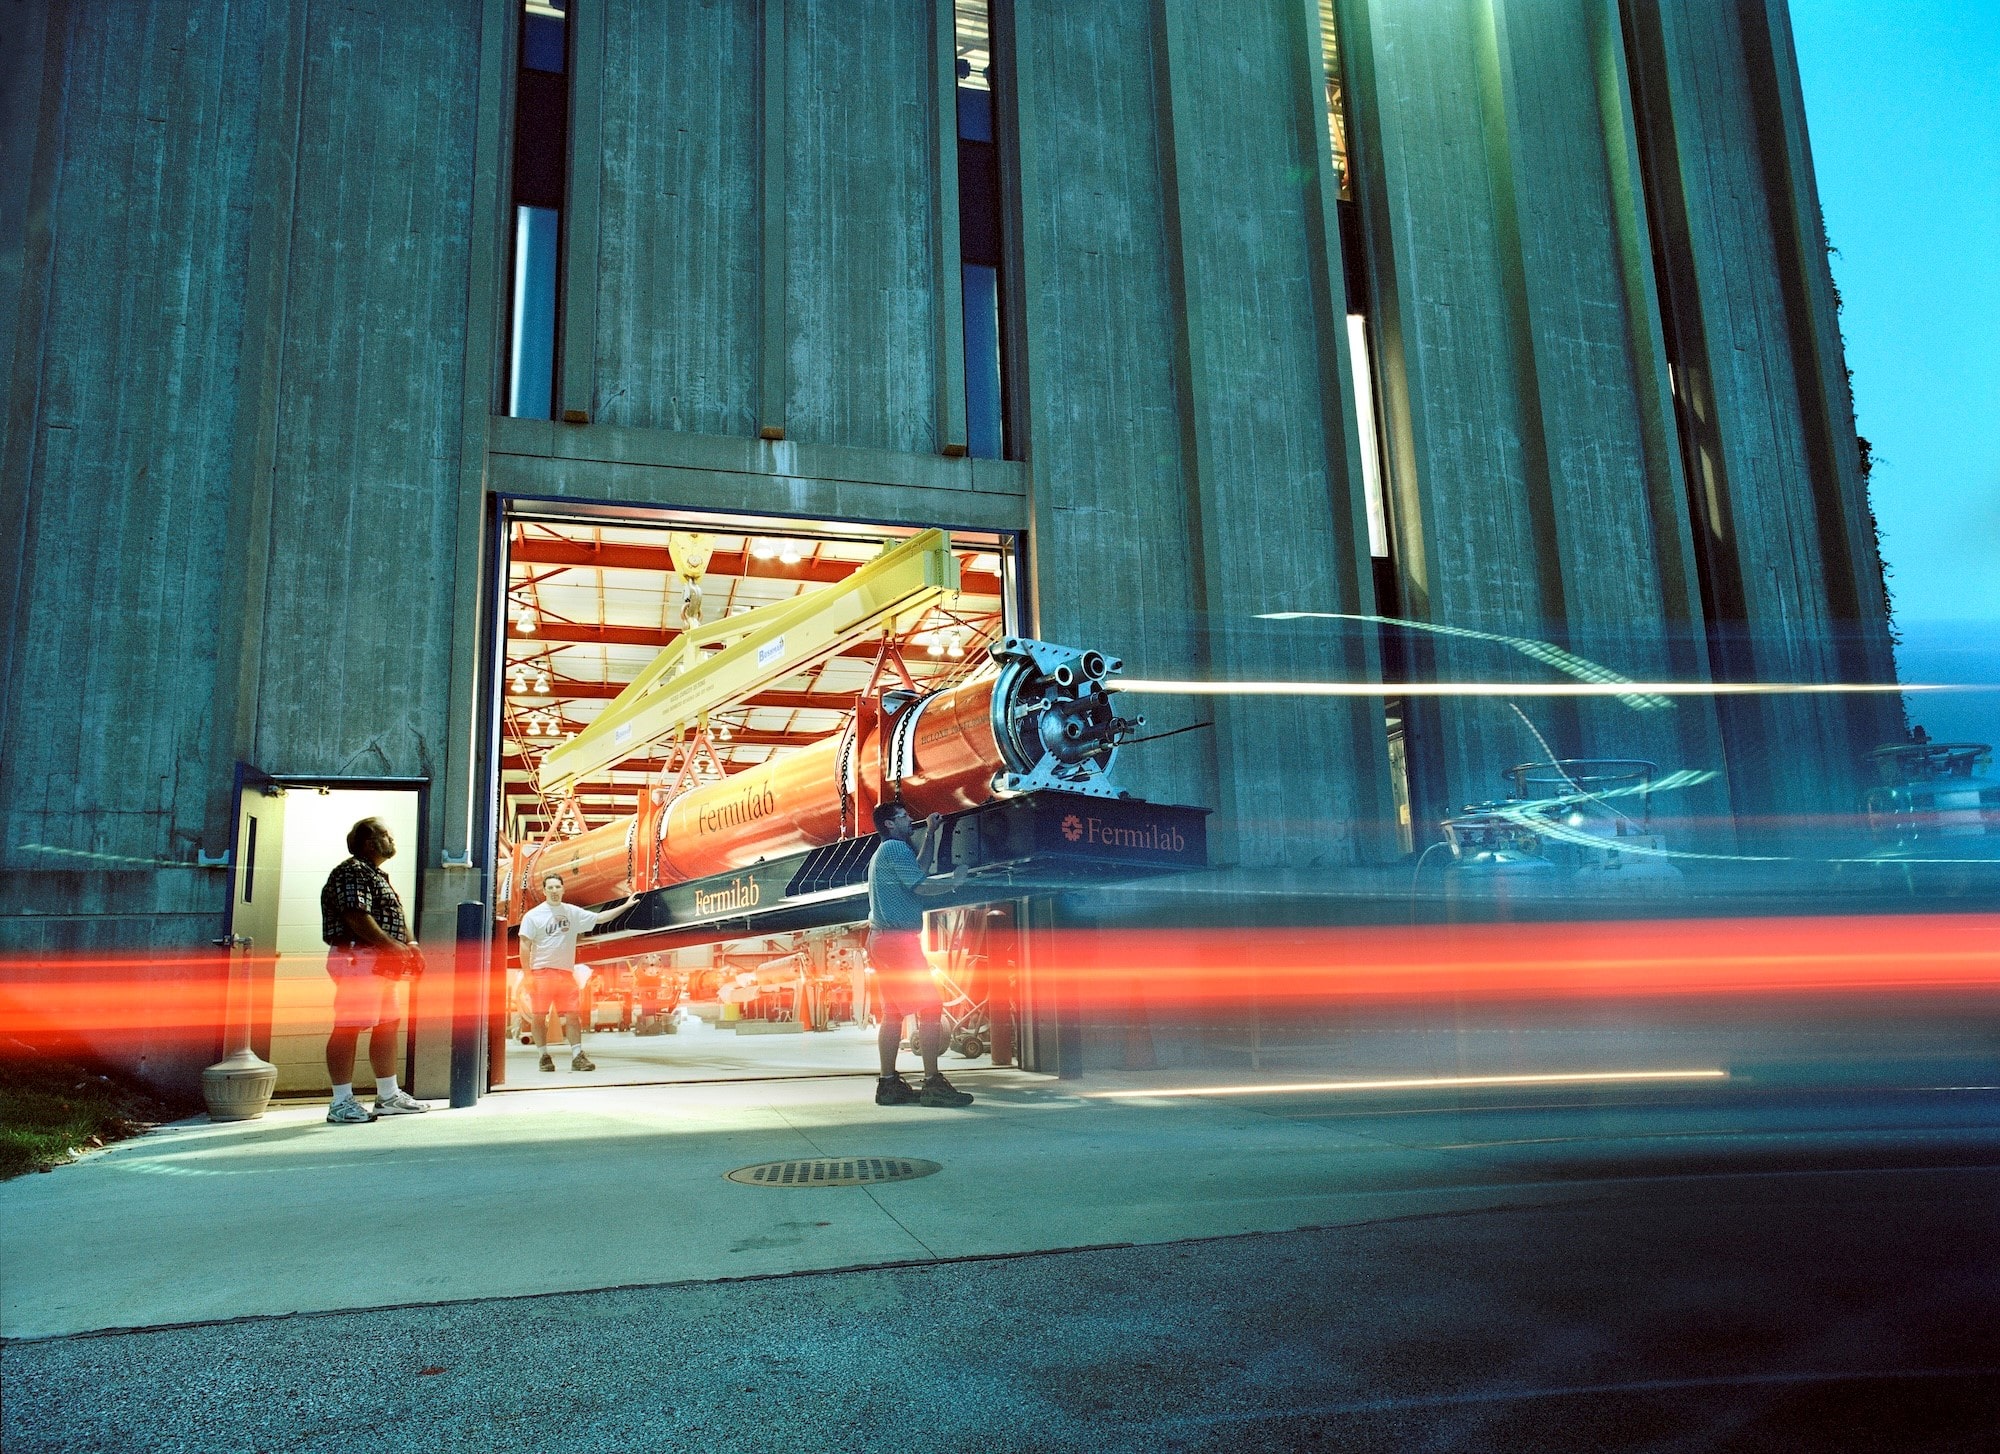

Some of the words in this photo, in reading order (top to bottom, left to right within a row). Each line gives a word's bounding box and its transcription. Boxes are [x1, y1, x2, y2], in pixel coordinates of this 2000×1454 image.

[698, 780, 774, 836] Fermilab
[1087, 817, 1185, 852] Fermilab
[695, 874, 760, 917] Fermilab
